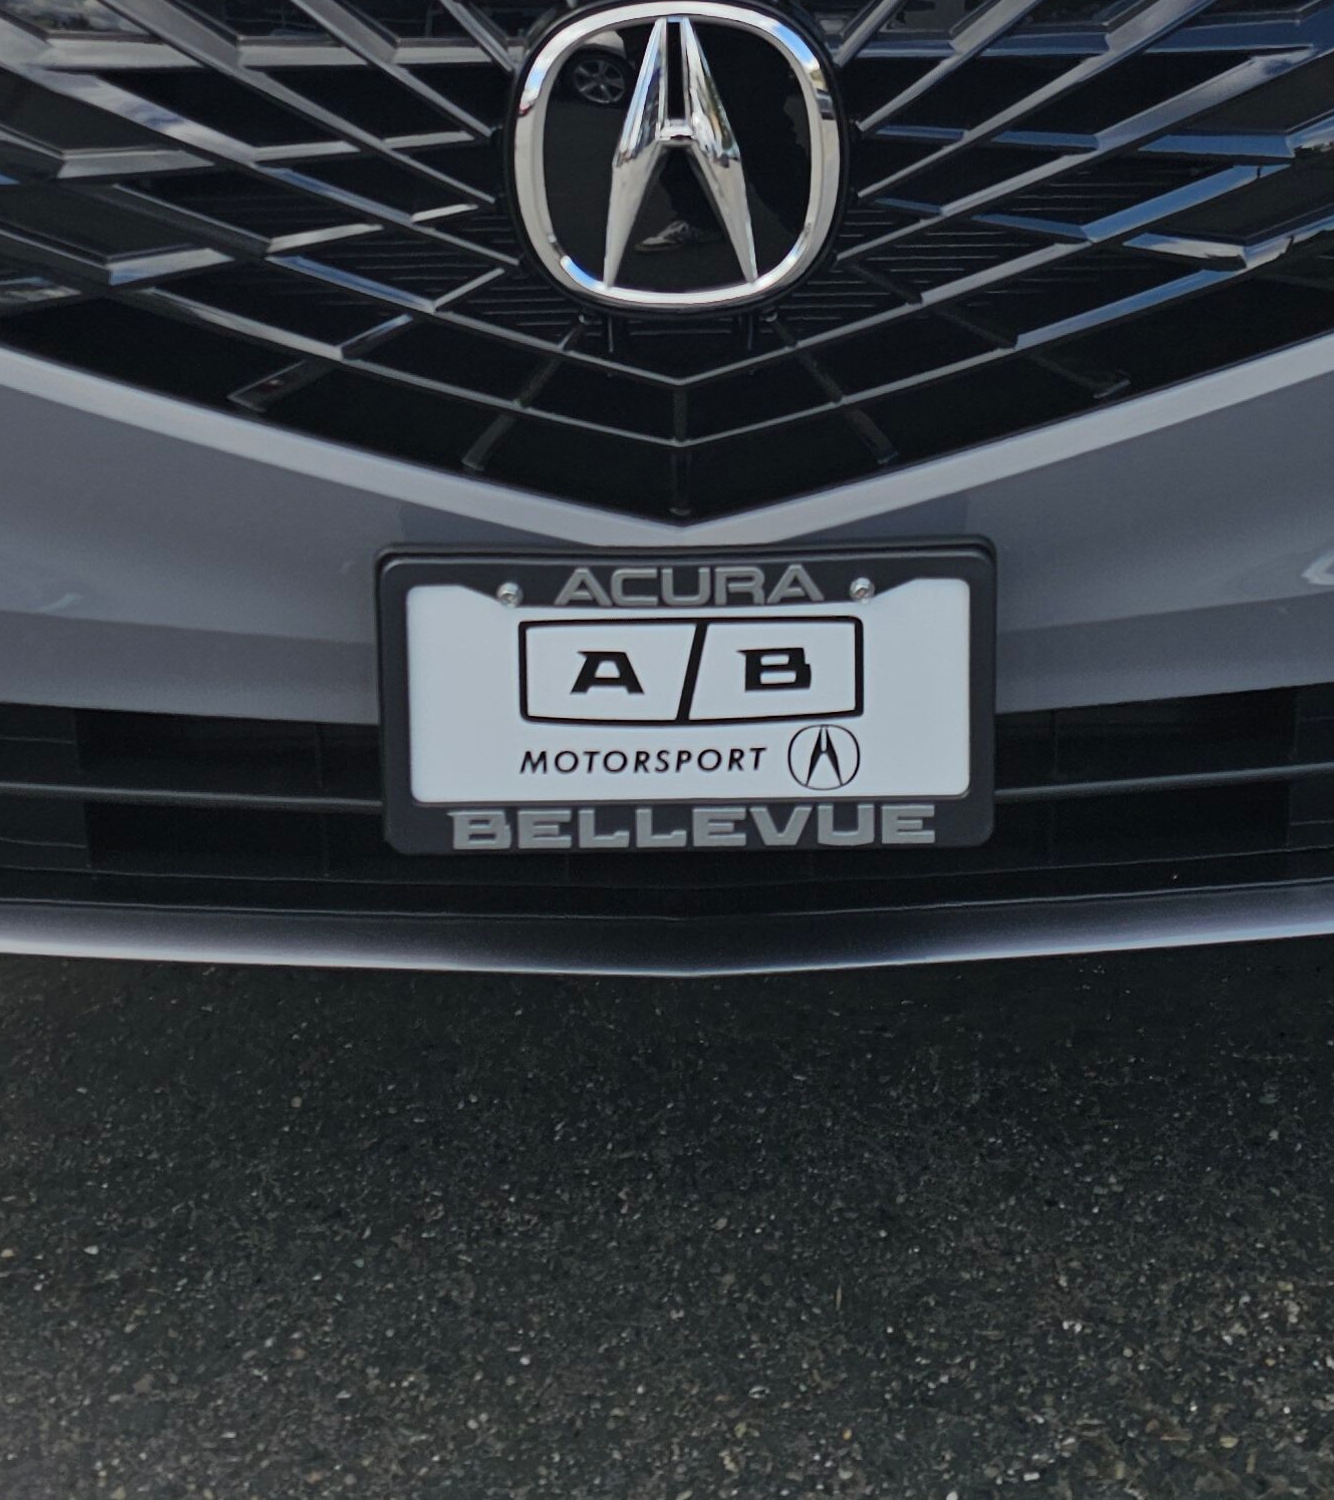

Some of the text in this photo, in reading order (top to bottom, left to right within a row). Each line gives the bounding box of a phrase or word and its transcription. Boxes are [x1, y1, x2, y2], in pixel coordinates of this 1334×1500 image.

[554, 564, 824, 607] ACURA
[519, 747, 768, 775] MOTORSPORT
[446, 803, 936, 851] BELLEVUE
